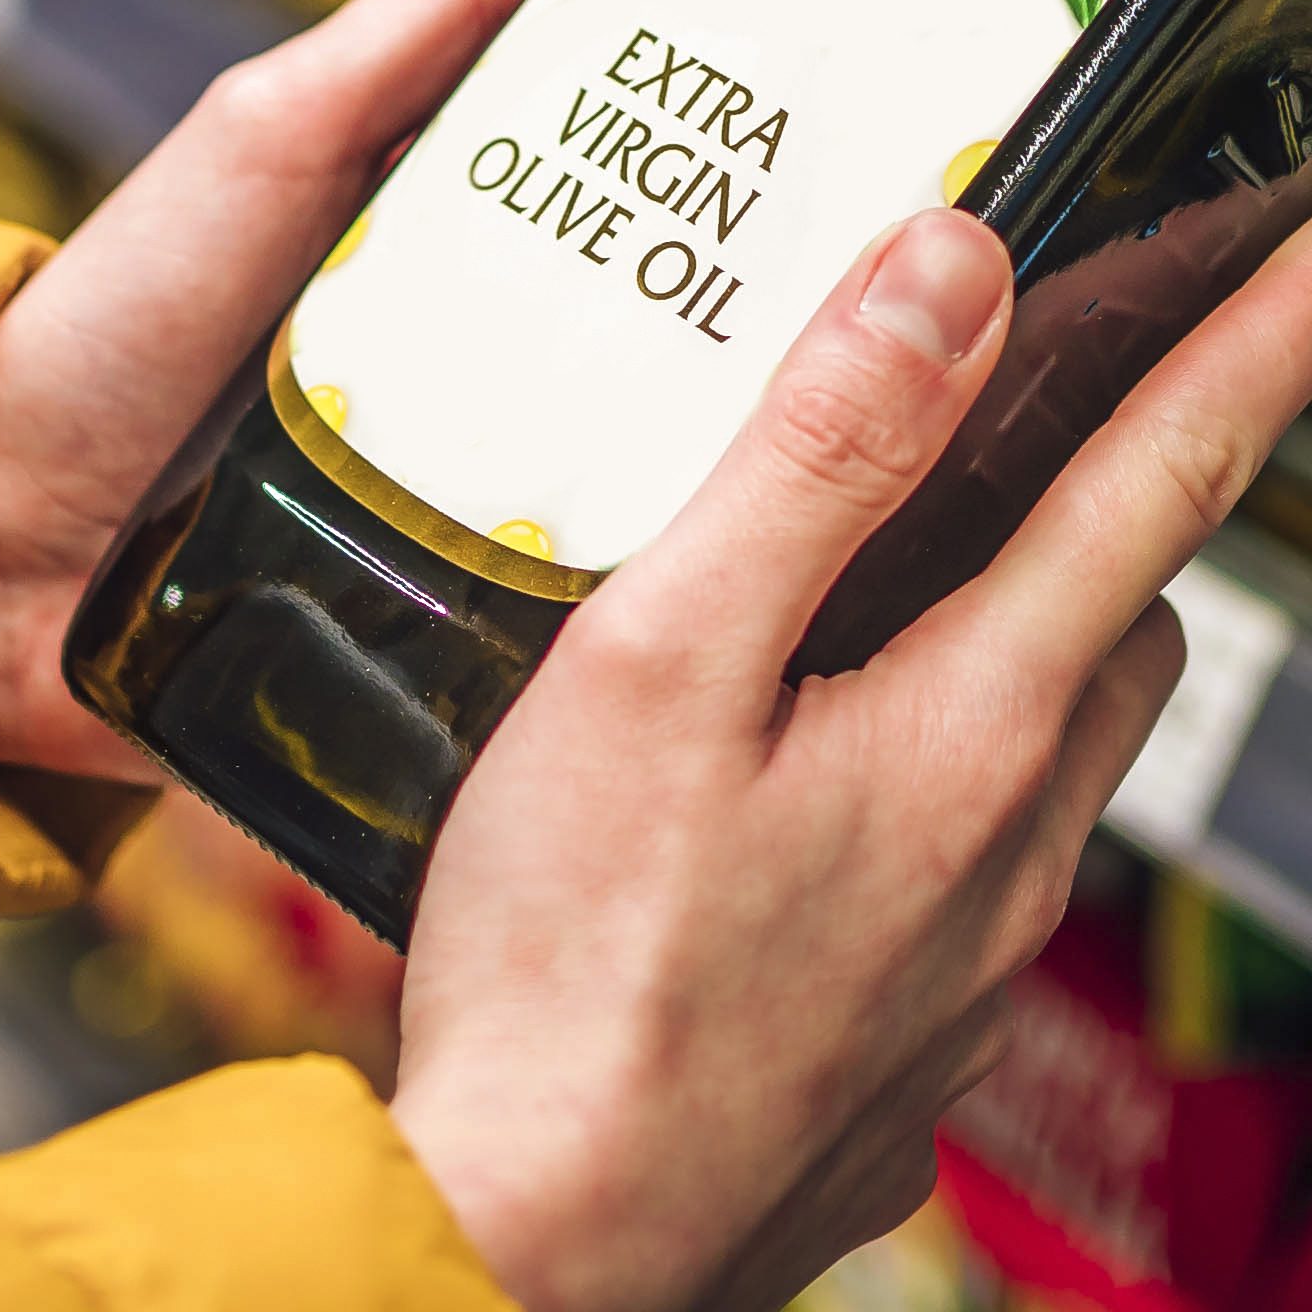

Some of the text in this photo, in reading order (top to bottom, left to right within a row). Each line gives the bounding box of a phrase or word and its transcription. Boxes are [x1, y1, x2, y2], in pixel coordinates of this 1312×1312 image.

[559, 87, 762, 245] VIRGIN
[604, 28, 790, 174] EXTRA
[469, 137, 745, 344] OLIVE OIL
